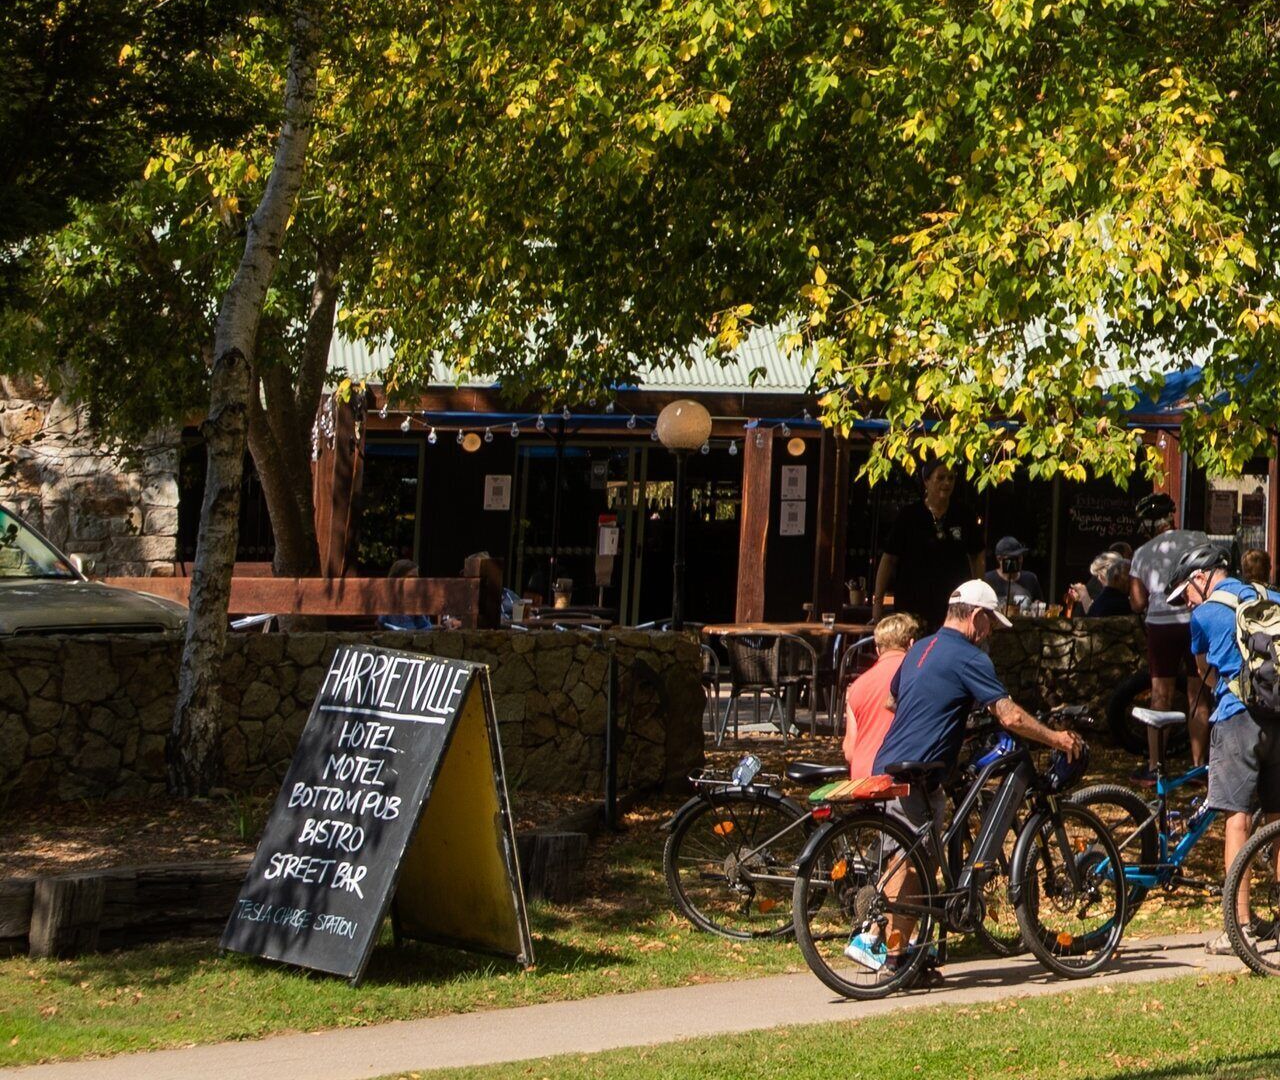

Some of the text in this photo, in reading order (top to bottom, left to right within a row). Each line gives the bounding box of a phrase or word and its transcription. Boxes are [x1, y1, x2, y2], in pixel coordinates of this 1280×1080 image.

[321, 649, 469, 714] HARRIETVILLE
[338, 720, 398, 753] HOTEL
[323, 754, 385, 786] MOTEL
[288, 782, 401, 820] BOTTOM PUB
[298, 818, 364, 853] BISTRO
[264, 852, 367, 899] STREET BAR
[237, 899, 358, 939] TESLA CHARGE STATION
